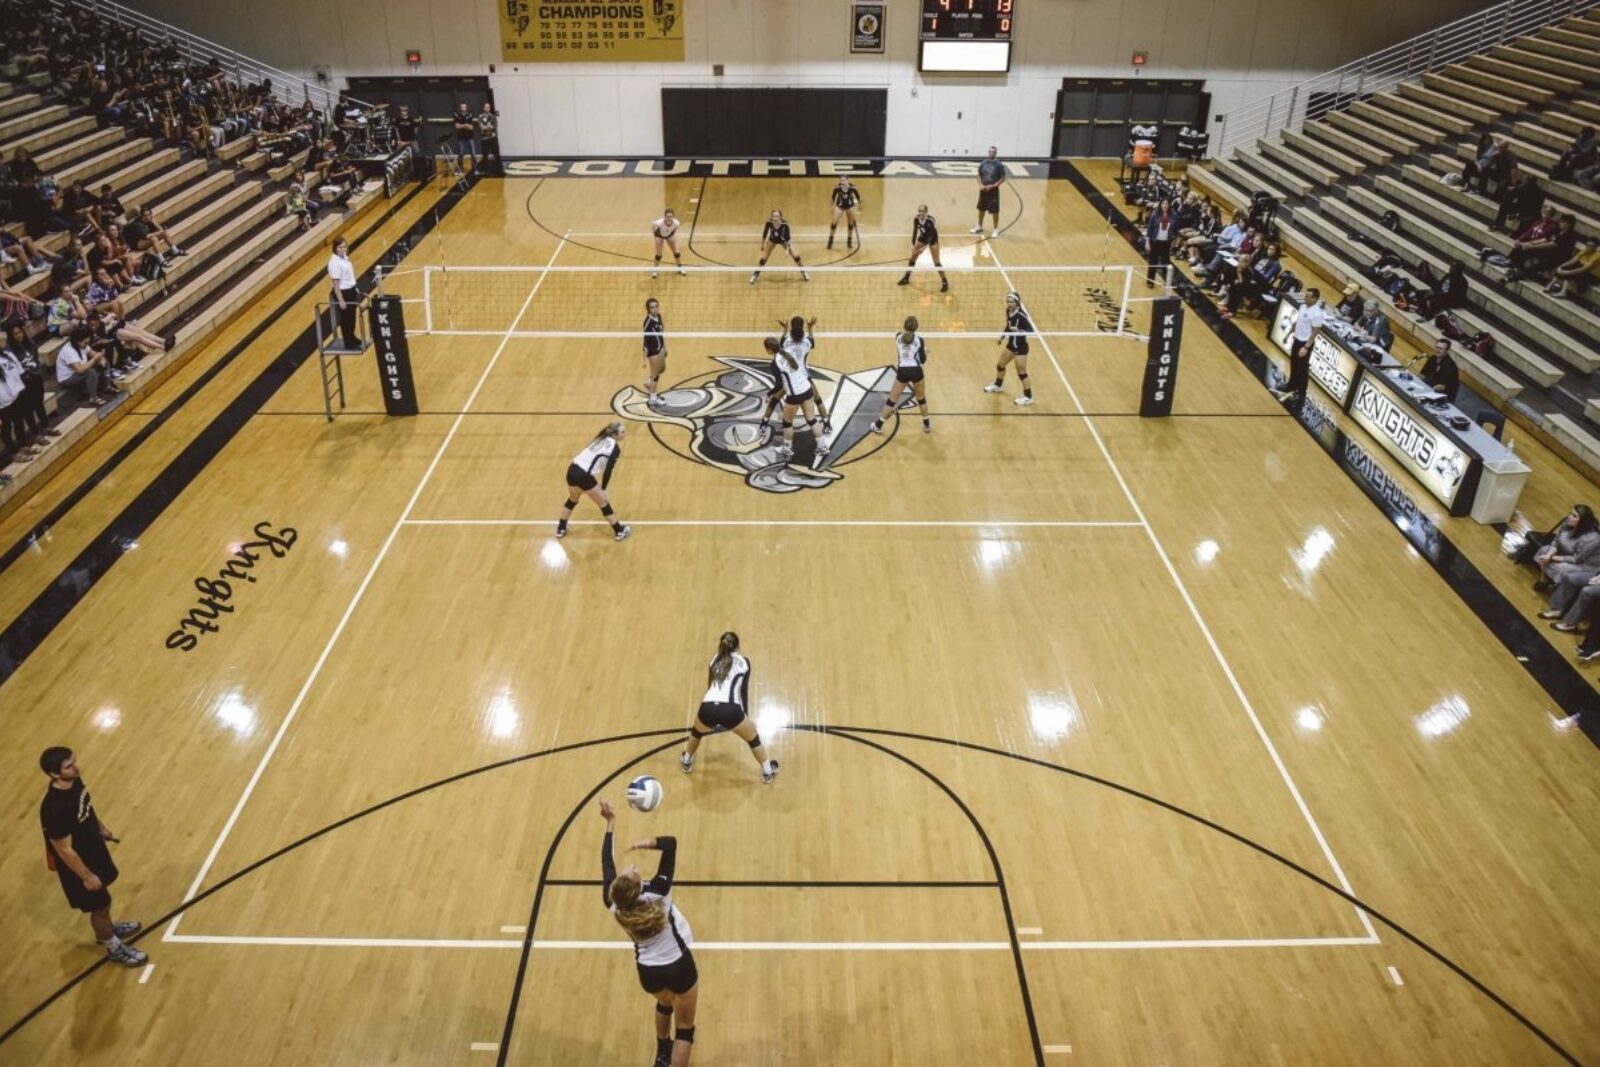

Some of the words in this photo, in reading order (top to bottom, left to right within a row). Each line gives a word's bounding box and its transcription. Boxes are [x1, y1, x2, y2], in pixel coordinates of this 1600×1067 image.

[539, 6, 644, 19] CHAMPIONS
[1001, 19, 1010, 32] 0
[504, 160, 1038, 176] SOUTHEAST
[378, 314, 402, 400] KNIGHTS
[1154, 314, 1175, 401] KNIGHTS
[1356, 380, 1436, 467] KNIGHTS
[165, 521, 298, 652] Knights
